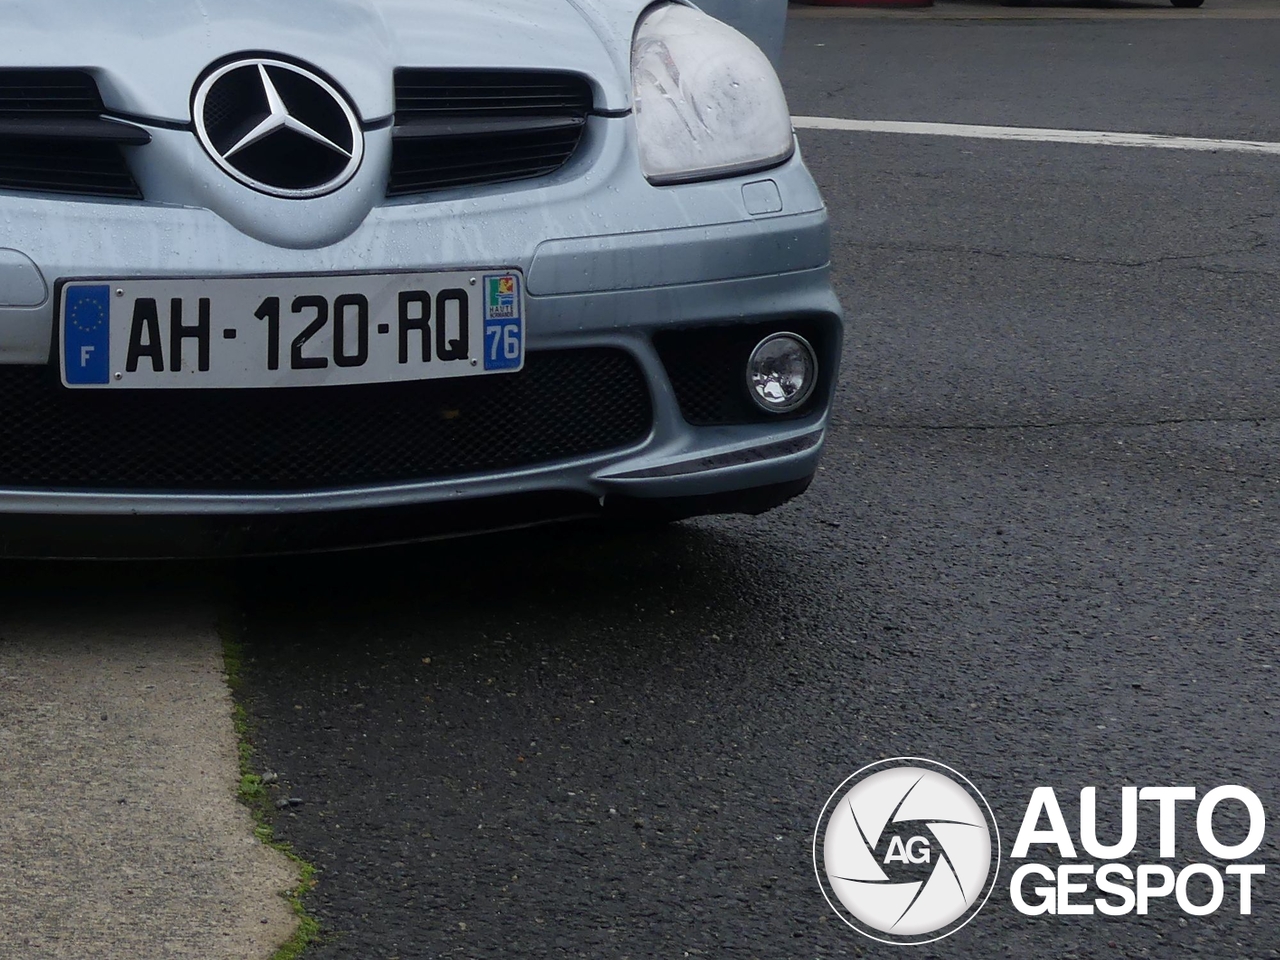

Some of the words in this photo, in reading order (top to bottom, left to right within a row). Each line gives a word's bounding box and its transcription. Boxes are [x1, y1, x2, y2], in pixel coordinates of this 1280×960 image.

[125, 288, 470, 372] AH-120-RQ
[486, 324, 519, 360] 76
[80, 345, 96, 368] F
